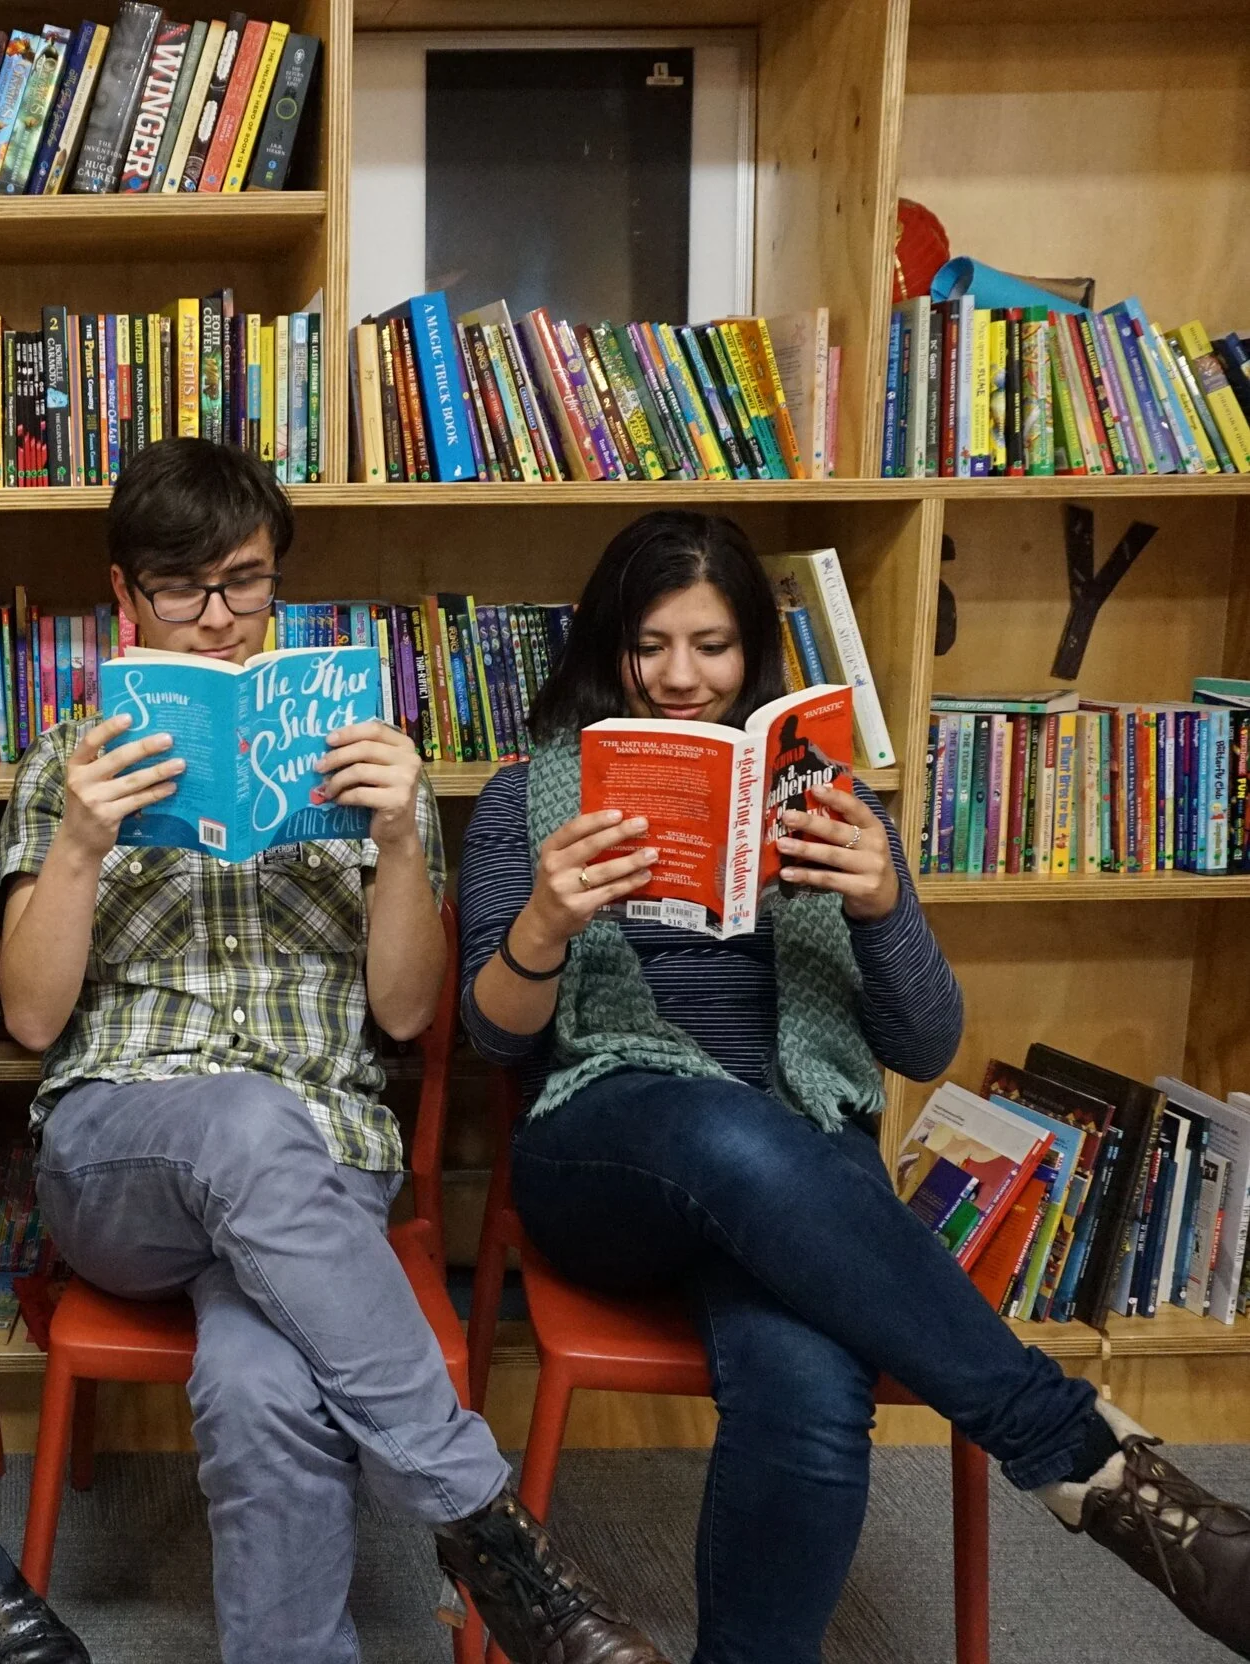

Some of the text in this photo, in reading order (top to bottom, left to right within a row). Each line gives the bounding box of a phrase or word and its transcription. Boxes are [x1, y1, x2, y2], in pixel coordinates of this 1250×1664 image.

[123, 42, 187, 177] WINGER
[77, 168, 119, 185] CABRET
[85, 159, 114, 174] HUGO
[50, 318, 59, 330] 2
[203, 307, 212, 353] COLFER
[212, 315, 220, 345] EOIN
[47, 338, 57, 388] CARMODY
[54, 344, 63, 381] ISOBELLE
[85, 340, 95, 377] PIRATE
[424, 304, 458, 446] A MAGIC TRICK BOOK
[506, 339, 524, 384] MISSION FOX
[135, 319, 145, 450] MORTIFIED MARTIN CHATTERTO
[251, 651, 370, 711] The Other
[278, 698, 327, 750] Side
[642, 748, 674, 756] WYNNE
[661, 742, 704, 754] SUCCESSOR
[1215, 740, 1226, 799] Butterfly Club
[734, 756, 754, 834] gathering
[286, 810, 332, 838] EMILY
[736, 830, 748, 840] of
[732, 842, 753, 901] shadows
